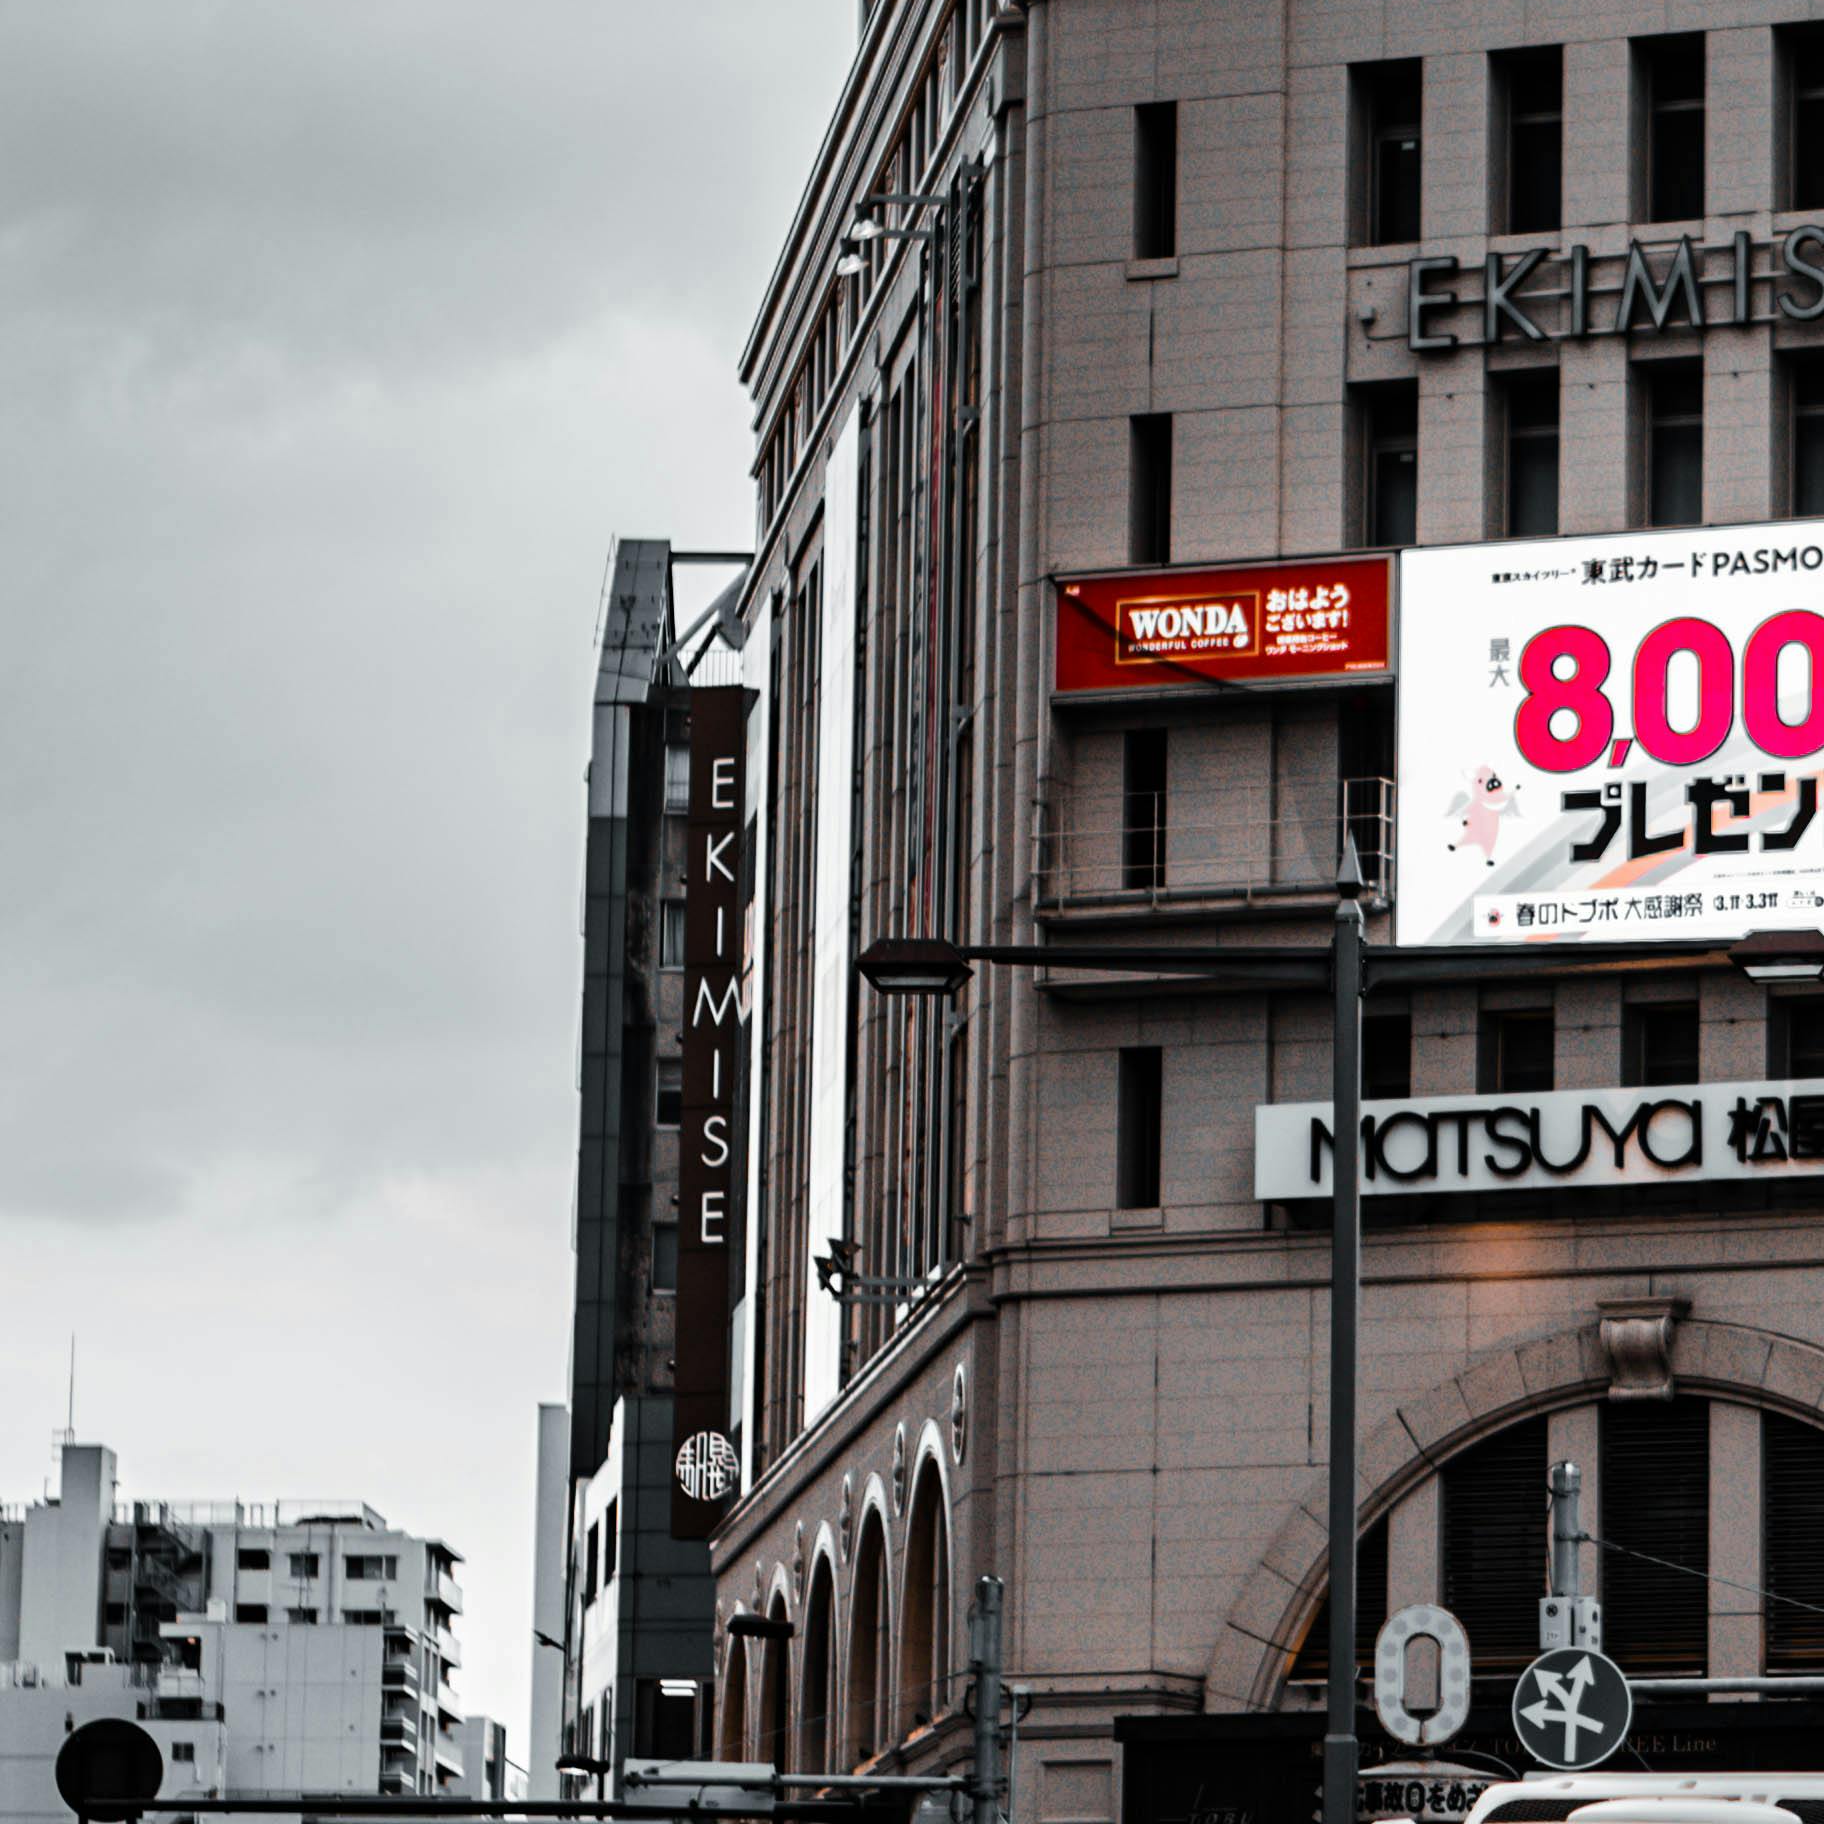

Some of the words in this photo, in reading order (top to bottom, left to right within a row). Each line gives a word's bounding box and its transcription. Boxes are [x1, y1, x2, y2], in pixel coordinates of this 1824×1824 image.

[1581, 553, 1708, 586] 東武カード
[1711, 545, 1823, 576] PASMO
[1265, 583, 1350, 613] おはよう
[1128, 603, 1248, 640] WONDA
[1127, 639, 1187, 653] WONDERFUL
[1190, 635, 1230, 649] COFFEE
[1489, 638, 1513, 689] 最大
[1516, 897, 1618, 926] 春のトブポ
[692, 756, 748, 1245] EKIMISE
